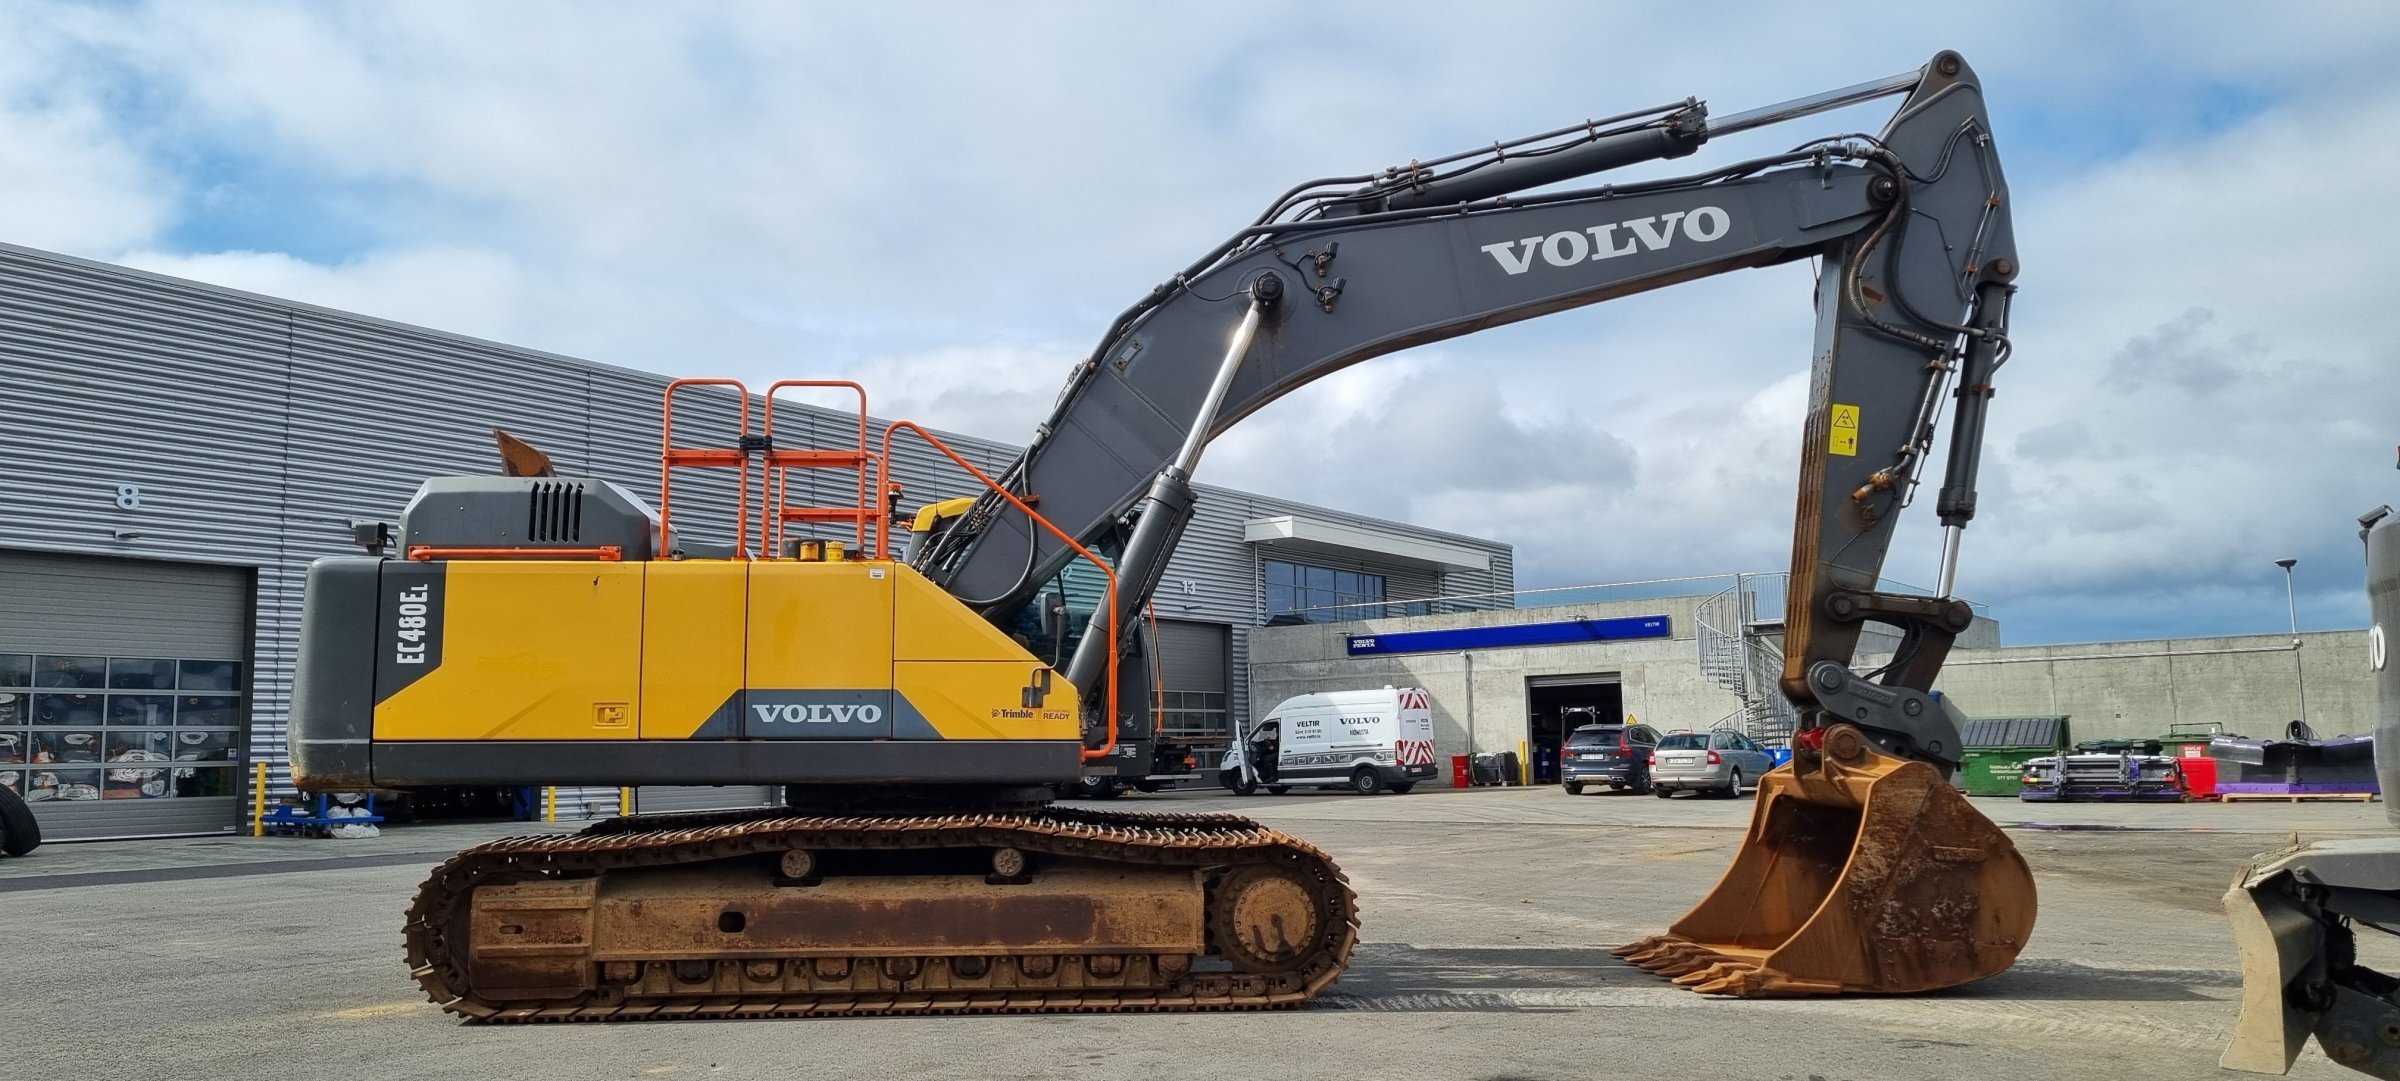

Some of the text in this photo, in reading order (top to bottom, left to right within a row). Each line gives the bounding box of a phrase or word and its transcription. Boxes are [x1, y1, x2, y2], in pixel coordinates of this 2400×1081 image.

[1481, 206, 1730, 275] VOLVO
[117, 484, 139, 509] 8
[1182, 580, 1196, 595] 13
[752, 704, 882, 723] VOLVO
[1001, 709, 1034, 718] Trimble
[1043, 712, 1070, 720] READY
[1296, 720, 1320, 728] VELTIR
[1340, 717, 1380, 725] VOLVO
